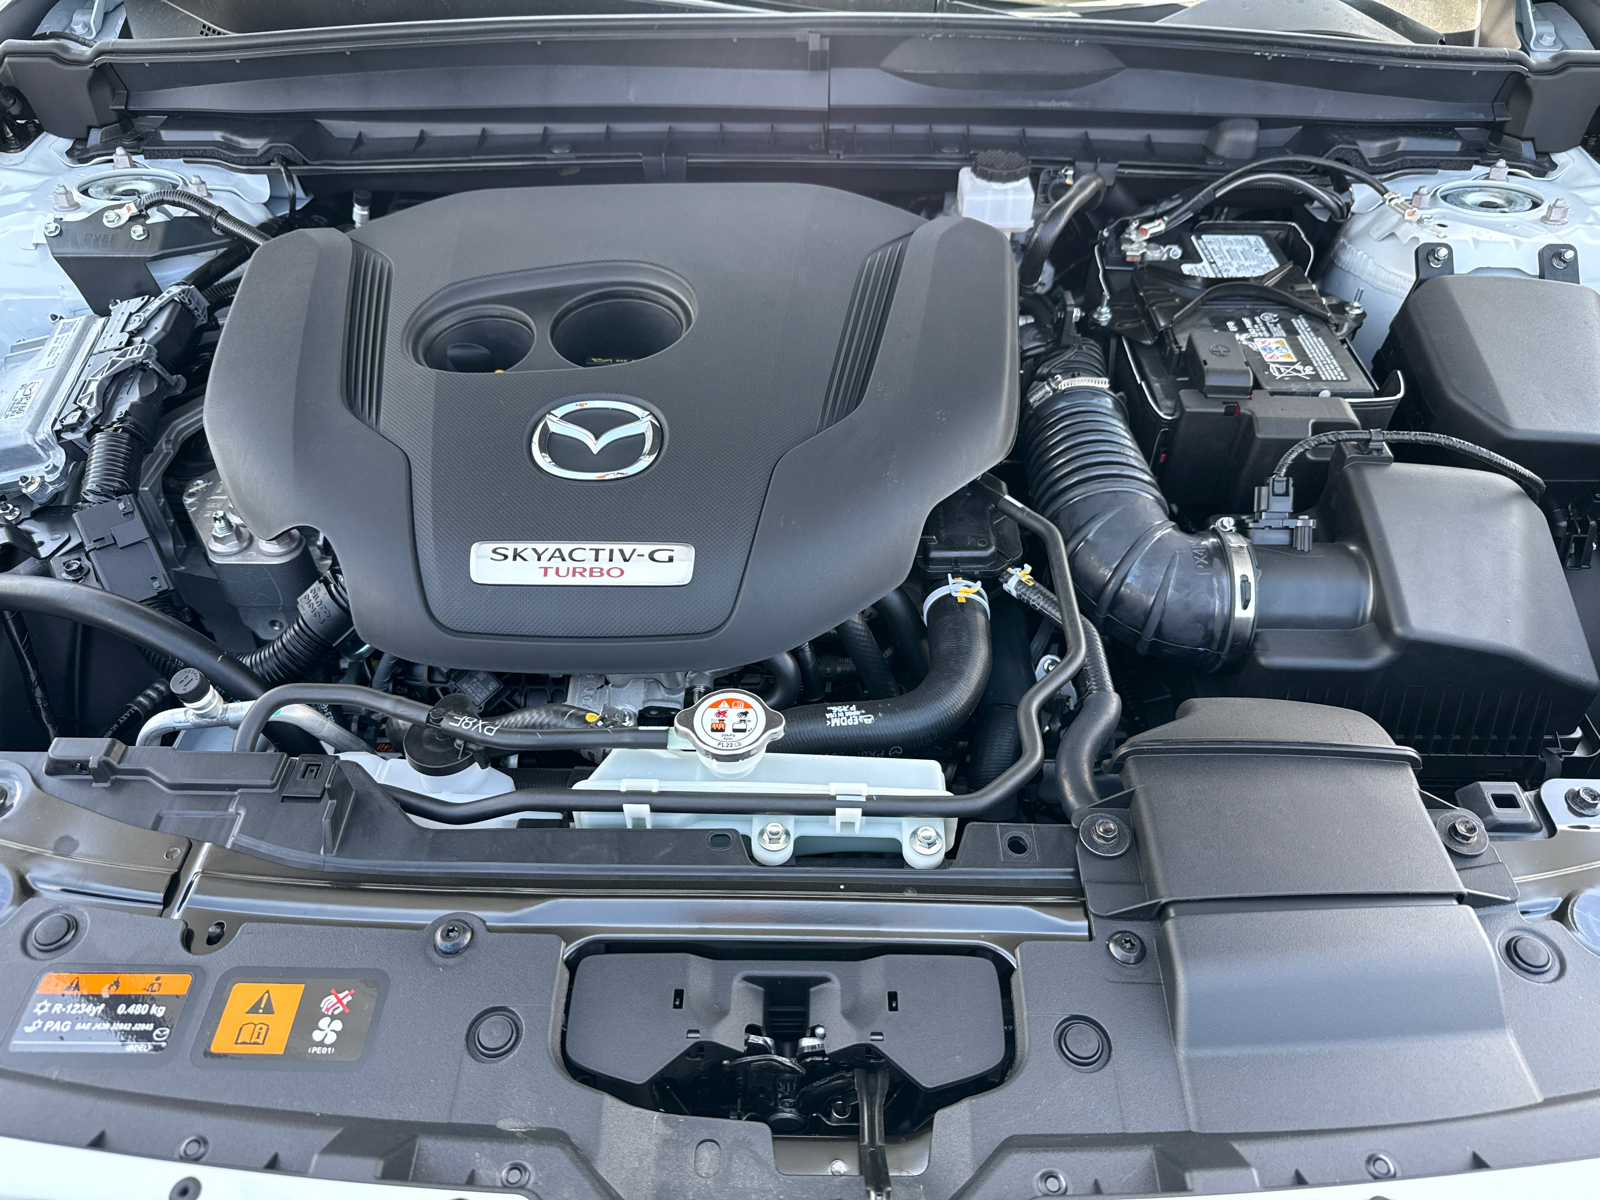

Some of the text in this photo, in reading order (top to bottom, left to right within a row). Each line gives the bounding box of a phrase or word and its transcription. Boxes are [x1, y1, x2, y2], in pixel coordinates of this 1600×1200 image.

[490, 546, 675, 563] SKYACTIV-G
[538, 566, 625, 578] TURBO
[449, 715, 502, 736] PX8F
[51, 1003, 166, 1017] R-1234yf 0.480 kg
[43, 1021, 72, 1031] PAG
[308, 1046, 335, 1054] (PE01)
